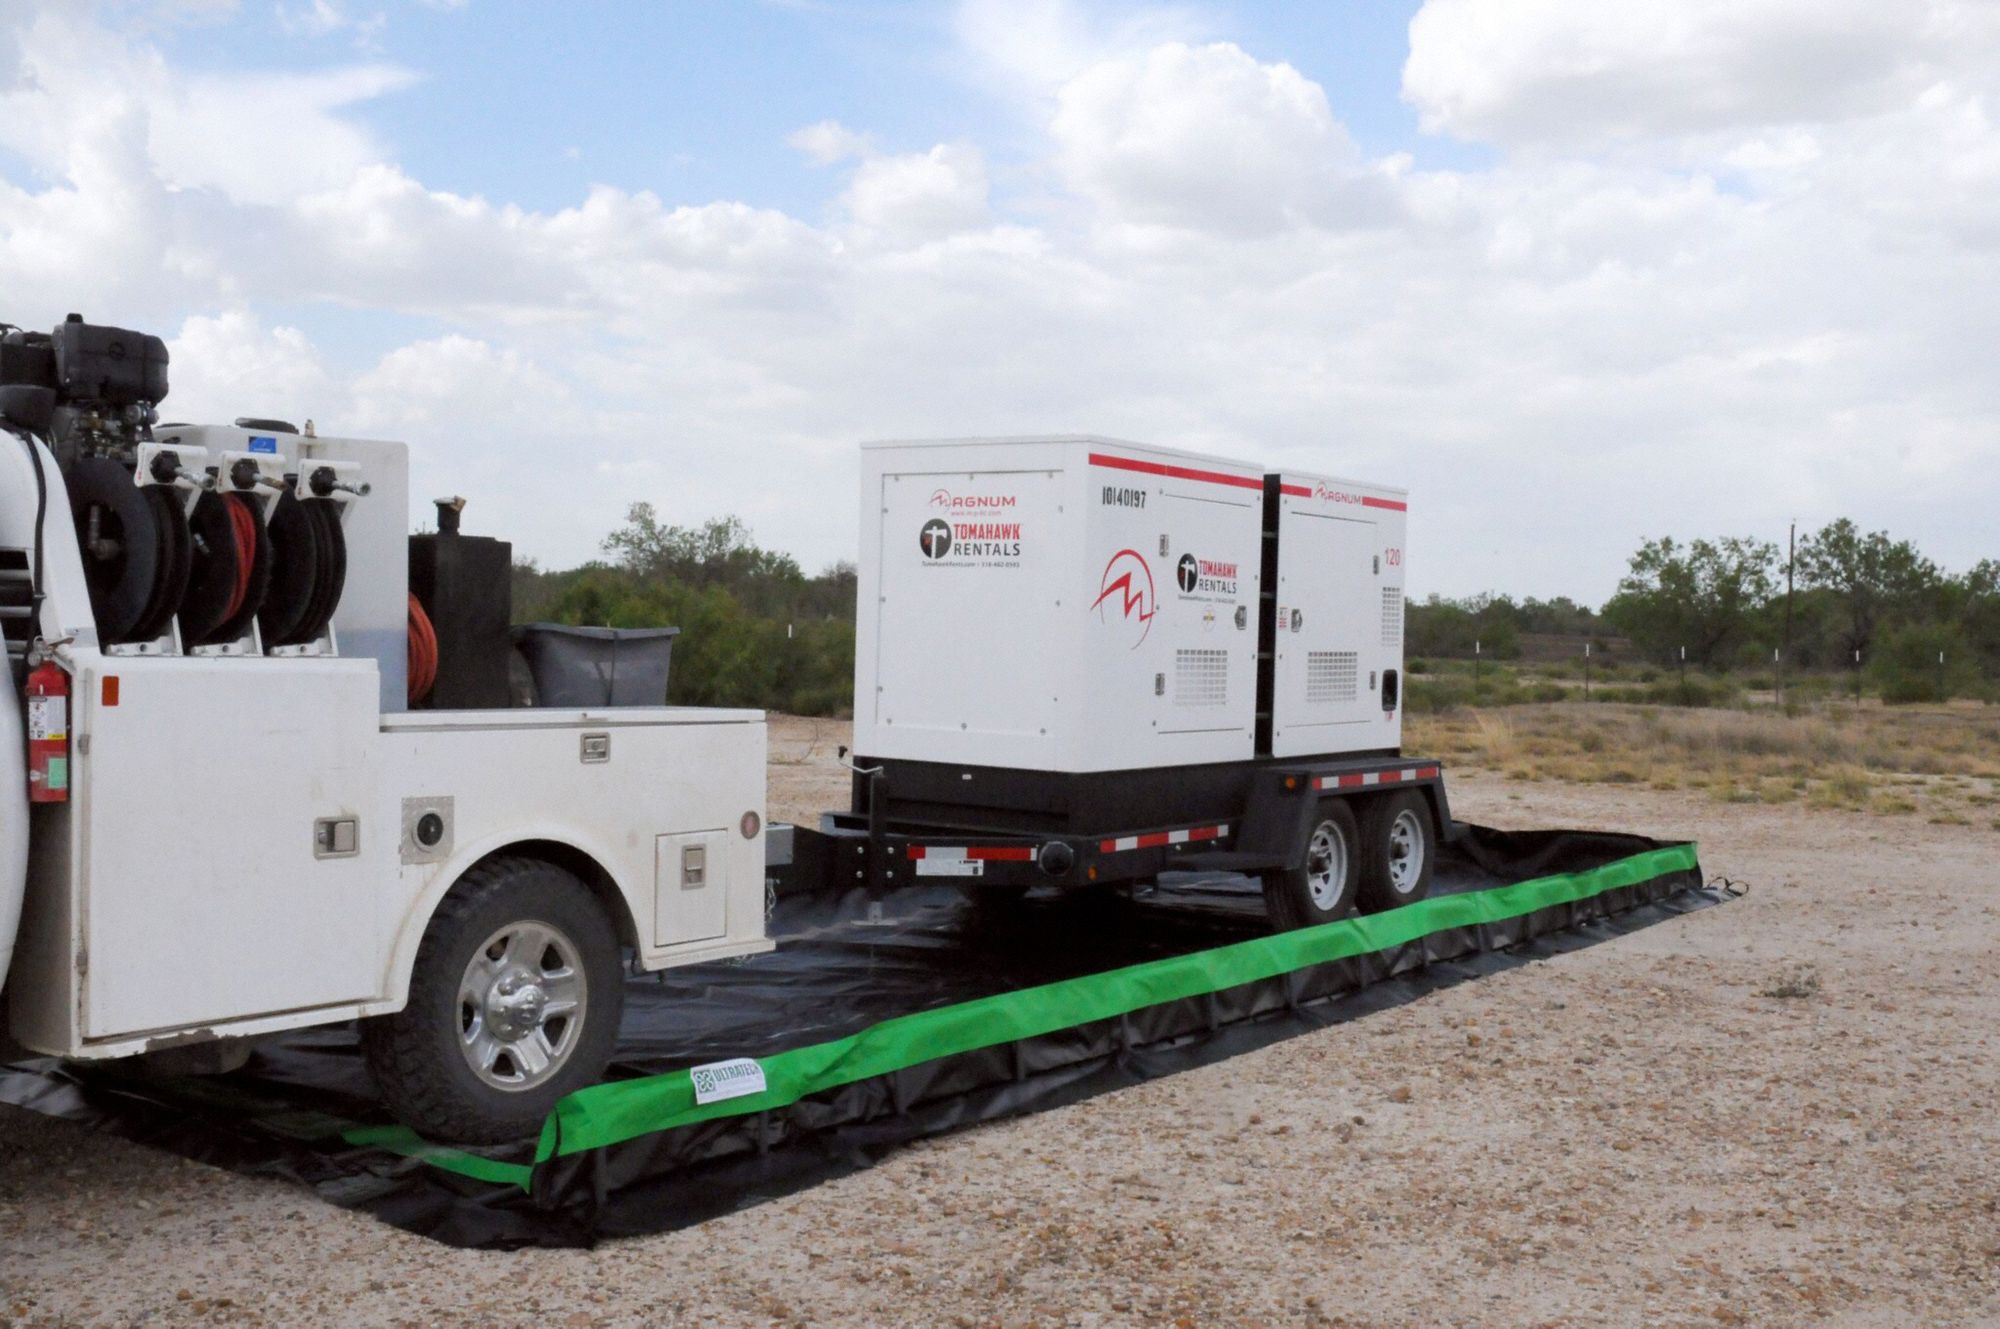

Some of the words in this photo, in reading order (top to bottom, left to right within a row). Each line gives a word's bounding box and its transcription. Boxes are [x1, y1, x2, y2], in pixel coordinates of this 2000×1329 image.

[929, 489, 1016, 508] MAGNUM
[1102, 486, 1147, 508] 10140197
[953, 523, 1020, 540] TOMAHAWK
[953, 543, 1020, 556] RENTALS
[1385, 548, 1401, 567] 120
[1199, 560, 1238, 579] TOMAHAWK
[1199, 579, 1238, 594] RENTALS
